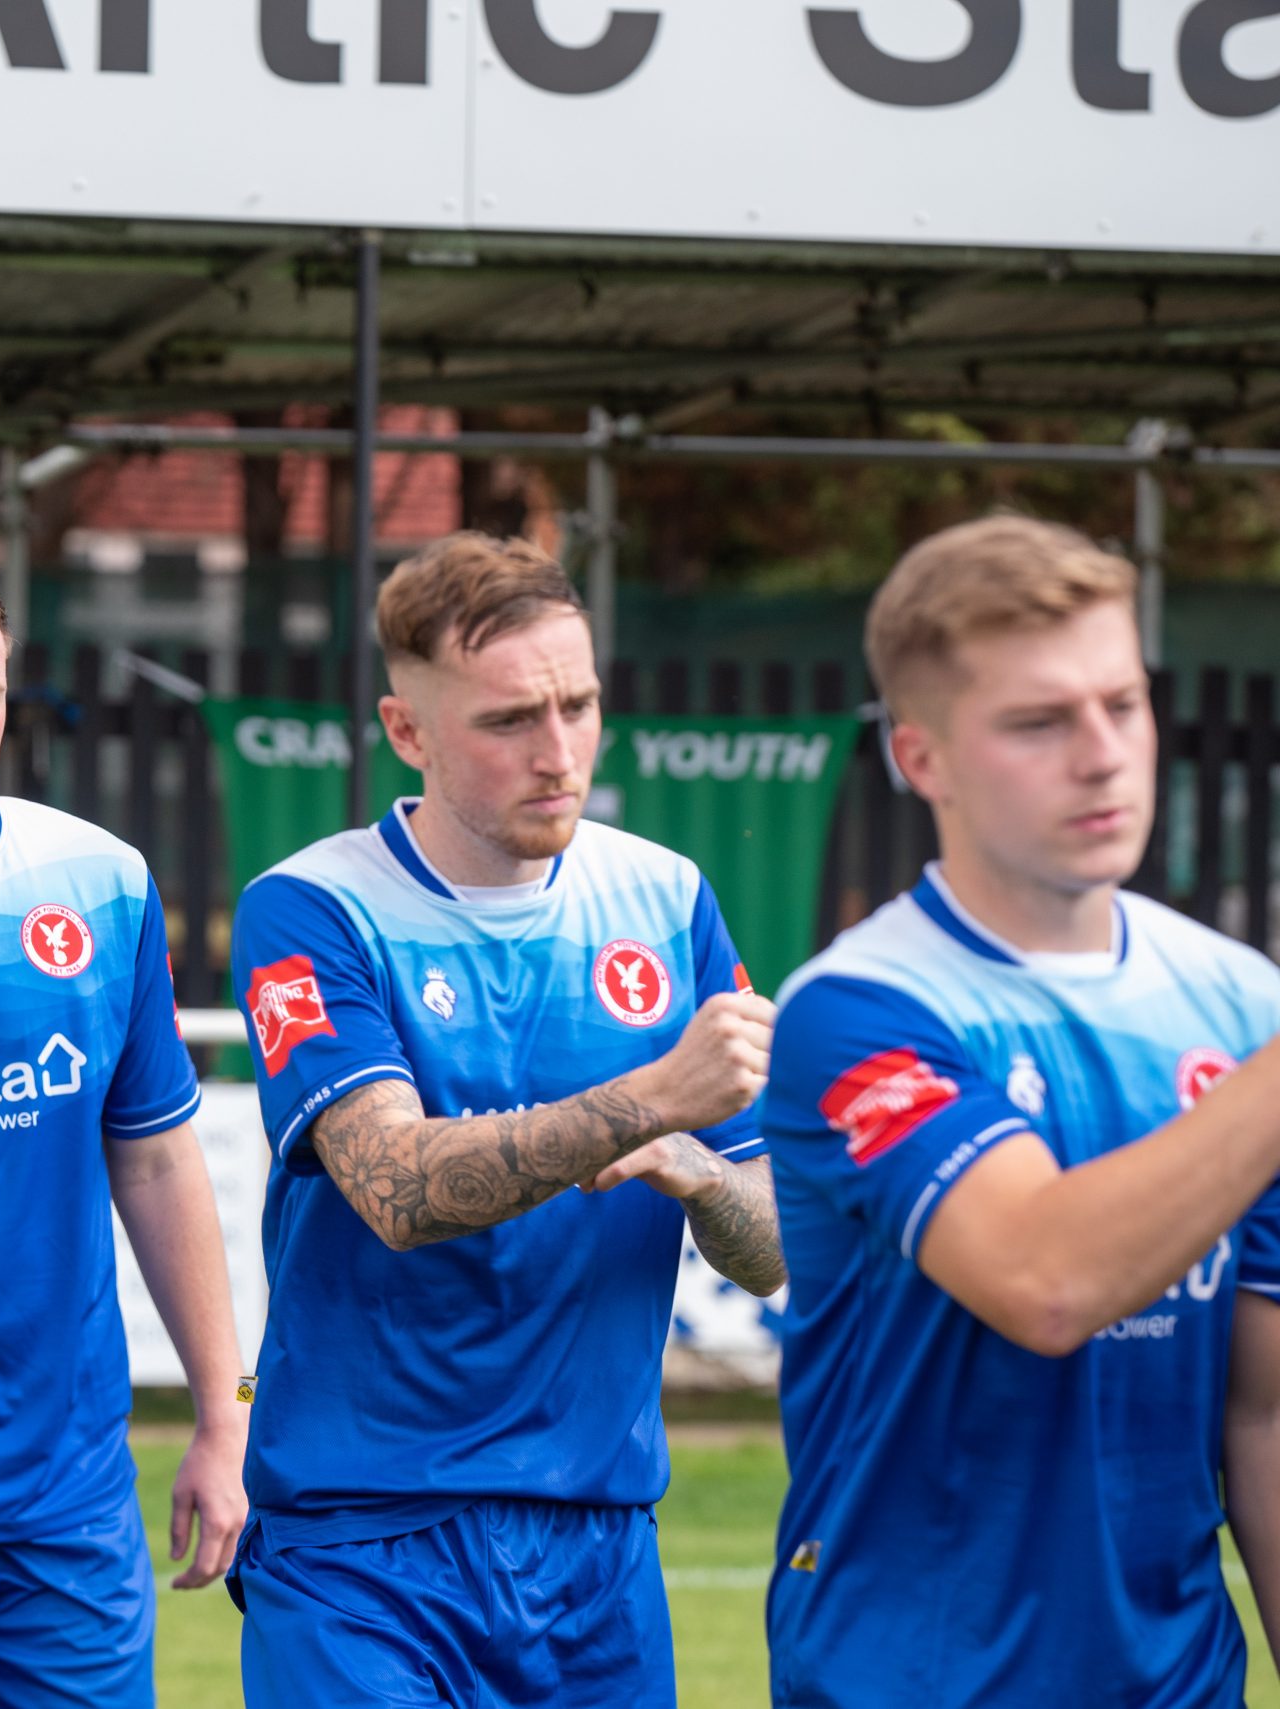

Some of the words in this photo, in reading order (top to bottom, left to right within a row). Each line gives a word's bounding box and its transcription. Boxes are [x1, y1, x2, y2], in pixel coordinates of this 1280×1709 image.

[631, 730, 833, 783] YOUTH
[303, 1085, 332, 1114] 1945
[1093, 1314, 1178, 1341] ower
